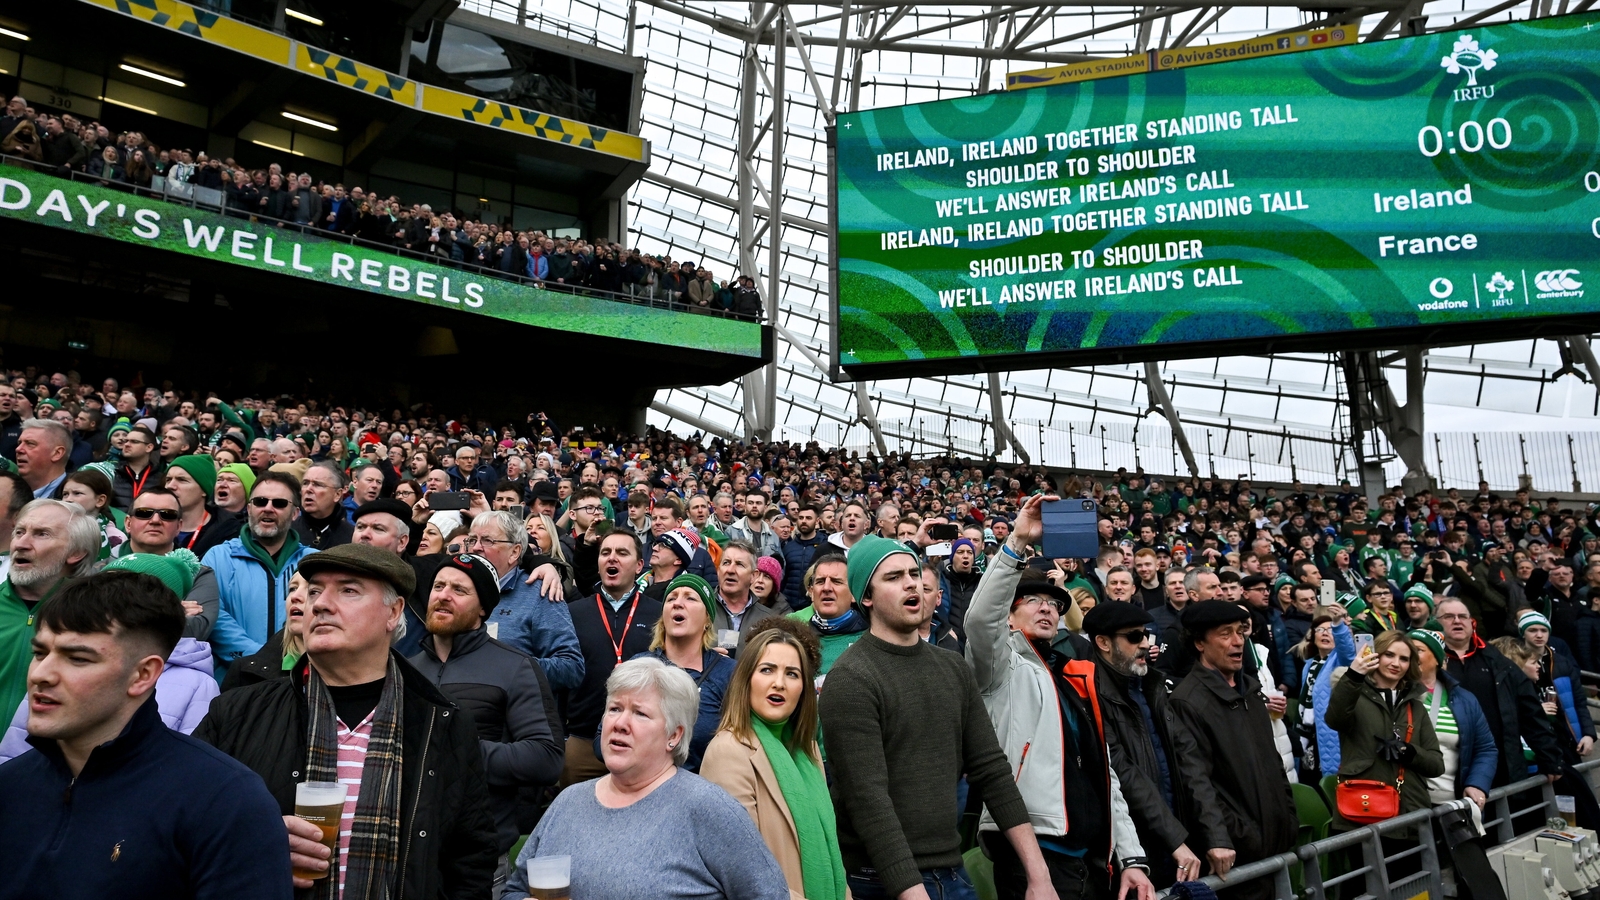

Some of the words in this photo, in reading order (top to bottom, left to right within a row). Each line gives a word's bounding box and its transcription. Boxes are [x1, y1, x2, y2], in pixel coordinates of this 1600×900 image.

[1160, 41, 1274, 67] @AvivaStadium
[1059, 68, 1093, 79] AVIVA
[1095, 60, 1145, 73] STADIUM
[48, 95, 72, 109] 330
[1453, 85, 1495, 102] IRFU
[877, 147, 954, 171] IRELAND,
[962, 136, 1037, 162] IRELAND
[1045, 124, 1139, 151] TOGETHER
[1146, 111, 1241, 139] STANDING
[1250, 105, 1299, 127] TALL
[1418, 118, 1513, 157] 0:00
[966, 161, 1059, 188] SHOULDER
[1066, 157, 1090, 176] TO
[1097, 145, 1196, 173] SHOULDER
[935, 196, 988, 218] WE'LL
[995, 187, 1072, 212] ANSWER
[1079, 175, 1177, 203] IRELAND'S
[1186, 170, 1235, 192] CALL
[1374, 184, 1473, 213] Ireland
[881, 225, 959, 251] IRELAND,
[968, 217, 1044, 242] IRELAND
[1051, 206, 1146, 234] TOGETHER
[1154, 195, 1252, 223] STANDING
[1259, 190, 1309, 213] TALL
[969, 251, 1063, 278] SHOULDER
[1071, 249, 1095, 269] TO
[1103, 239, 1204, 268] SHOULDER
[1379, 233, 1478, 257] France
[183, 218, 313, 273] WELL
[331, 252, 484, 308] REBELS
[938, 286, 992, 308] WE'LL
[999, 279, 1077, 304] ANSWER
[1086, 270, 1184, 296] IRELAND'S
[1193, 266, 1243, 289] CALL
[1536, 289, 1584, 300] canterbury
[1418, 299, 1468, 311] vodafone
[1492, 298, 1513, 307] IRFU
